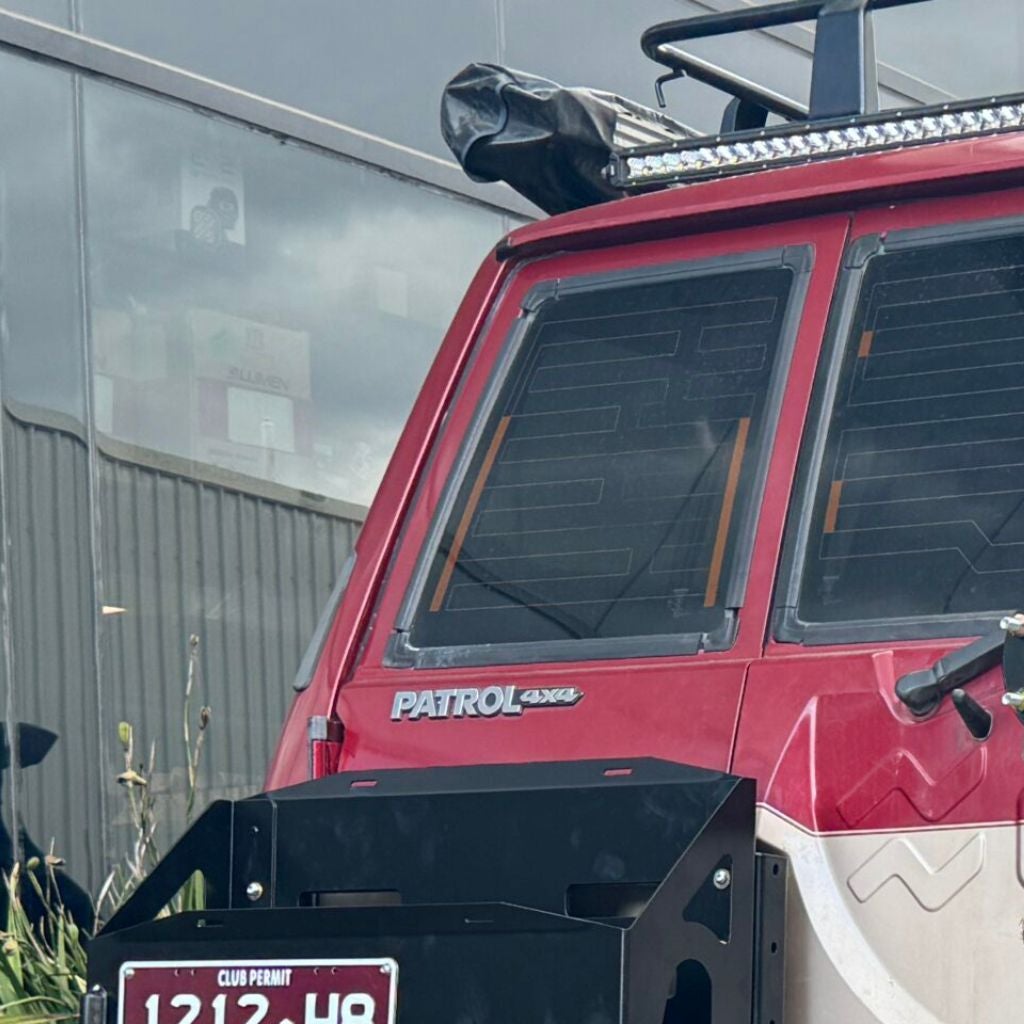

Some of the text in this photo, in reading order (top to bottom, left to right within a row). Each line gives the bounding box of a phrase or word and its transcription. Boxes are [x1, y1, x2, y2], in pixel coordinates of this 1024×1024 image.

[390, 685, 524, 721] PATROL
[217, 968, 293, 987] CLUB PERMIT
